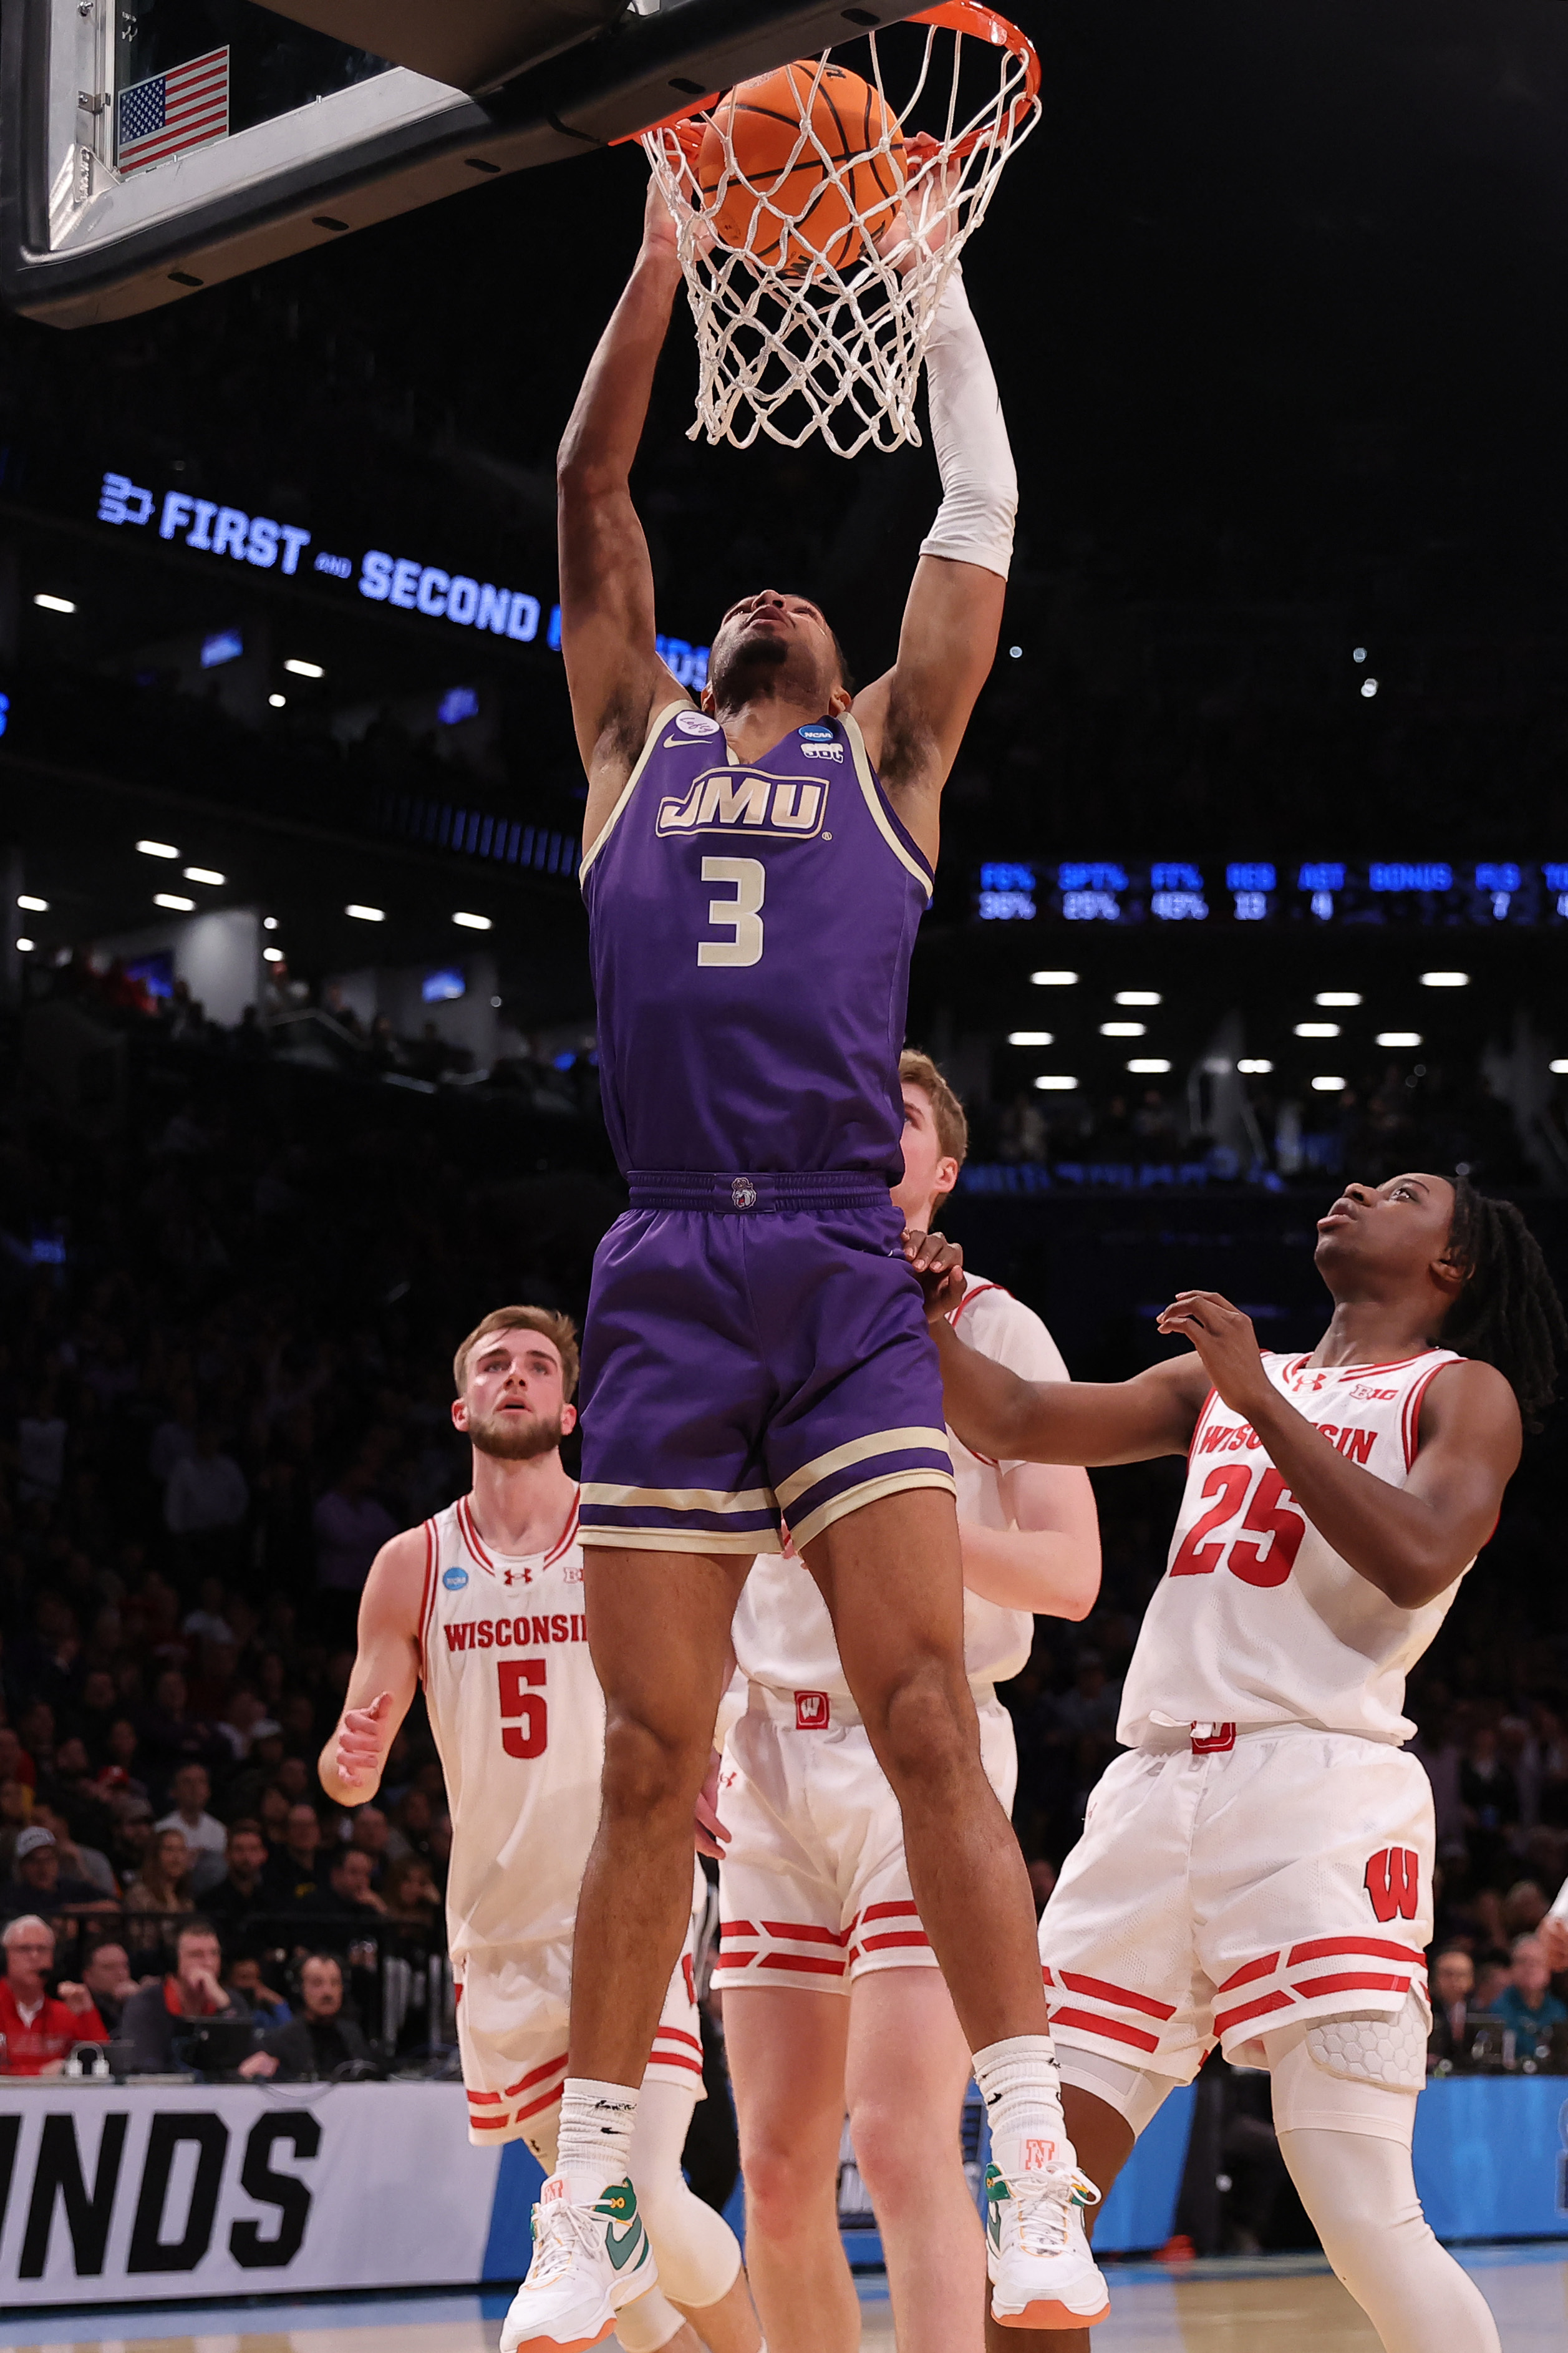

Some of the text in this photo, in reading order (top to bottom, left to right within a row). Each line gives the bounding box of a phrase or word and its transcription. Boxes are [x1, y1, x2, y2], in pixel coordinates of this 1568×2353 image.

[160, 491, 311, 575] FIRST
[358, 550, 541, 642] SECOND
[800, 743, 843, 764] SBC
[658, 774, 823, 831] JMU
[697, 856, 765, 967] 3
[1199, 1420, 1378, 1465] WISCSIN
[1169, 1464, 1305, 1588] 25
[498, 1659, 547, 1759] 5
[1363, 1846, 1418, 1923] W
